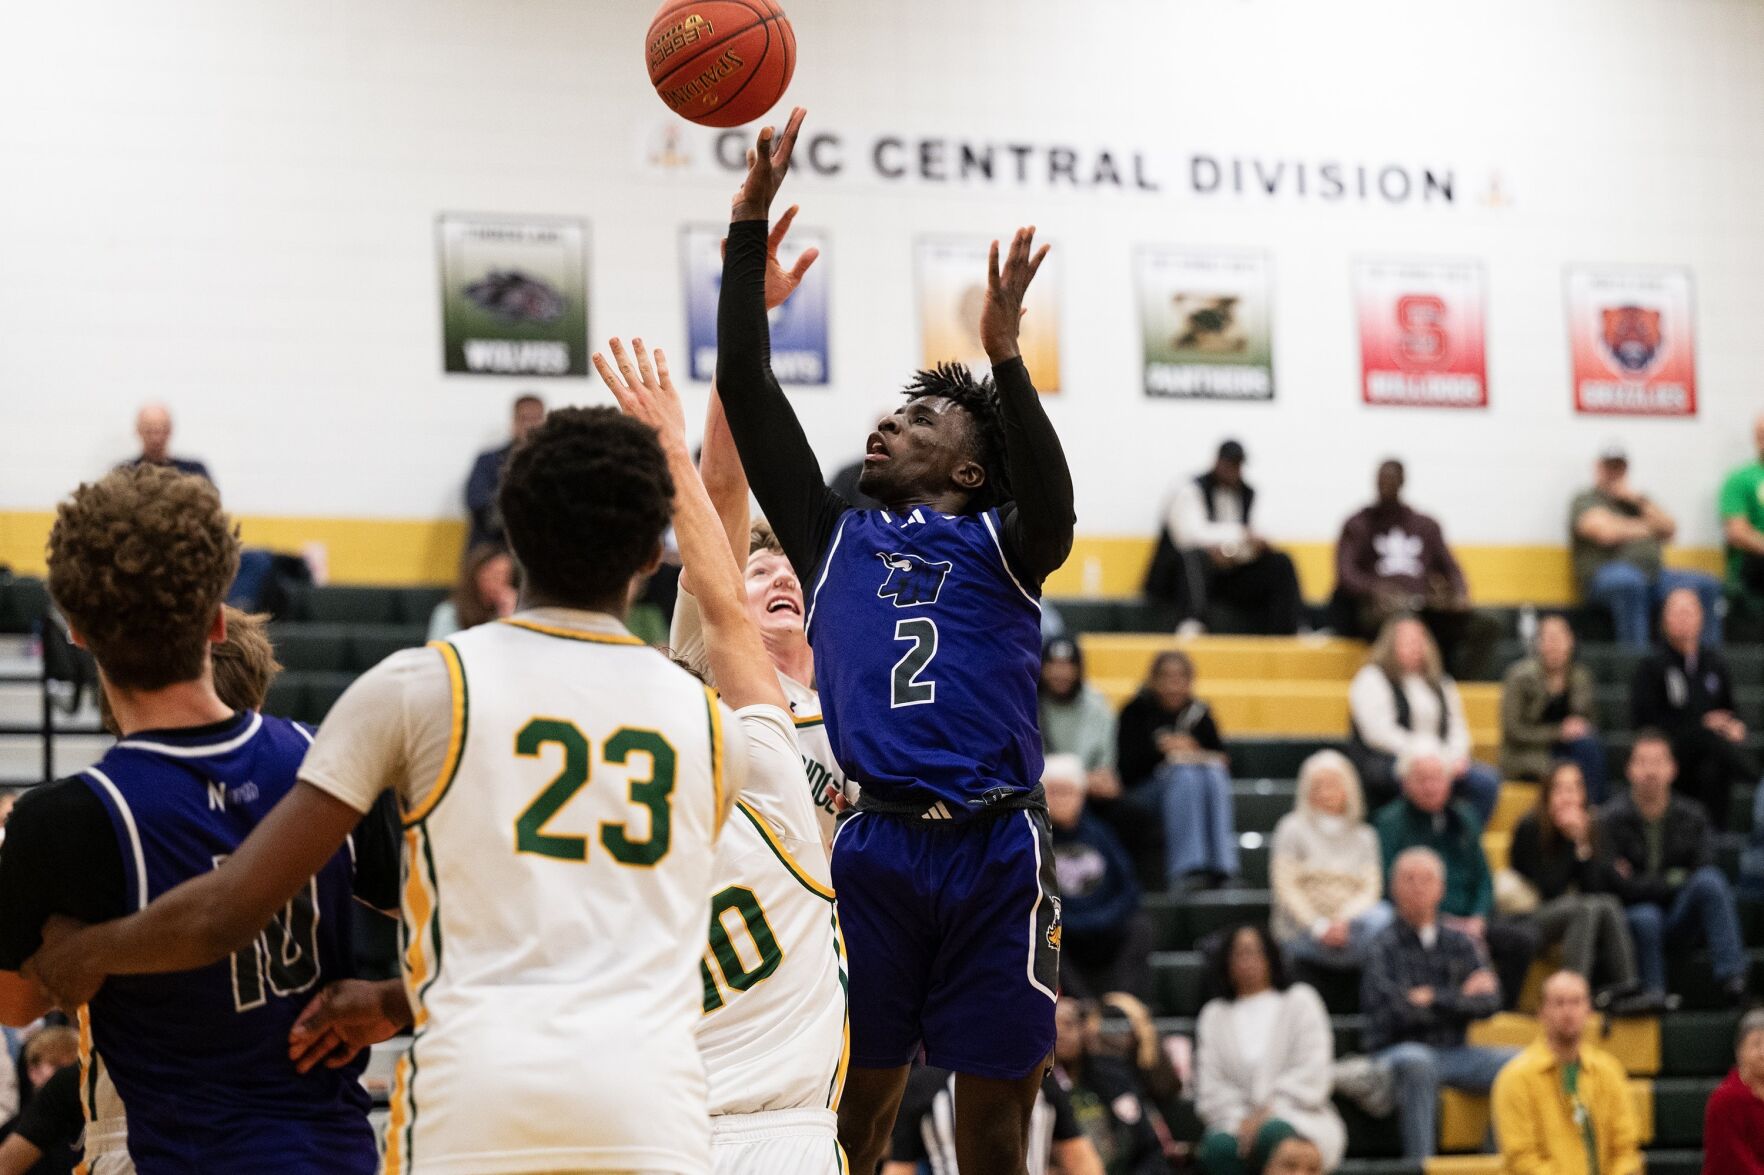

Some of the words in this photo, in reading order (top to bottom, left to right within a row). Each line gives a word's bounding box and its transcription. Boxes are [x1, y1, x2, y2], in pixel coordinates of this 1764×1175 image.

[714, 129, 842, 176] GC
[873, 133, 1158, 190] CENTRAL
[1190, 154, 1456, 203] DIVISION
[891, 617, 938, 709] 2
[513, 715, 677, 869] 23
[801, 754, 841, 815] IDGE
